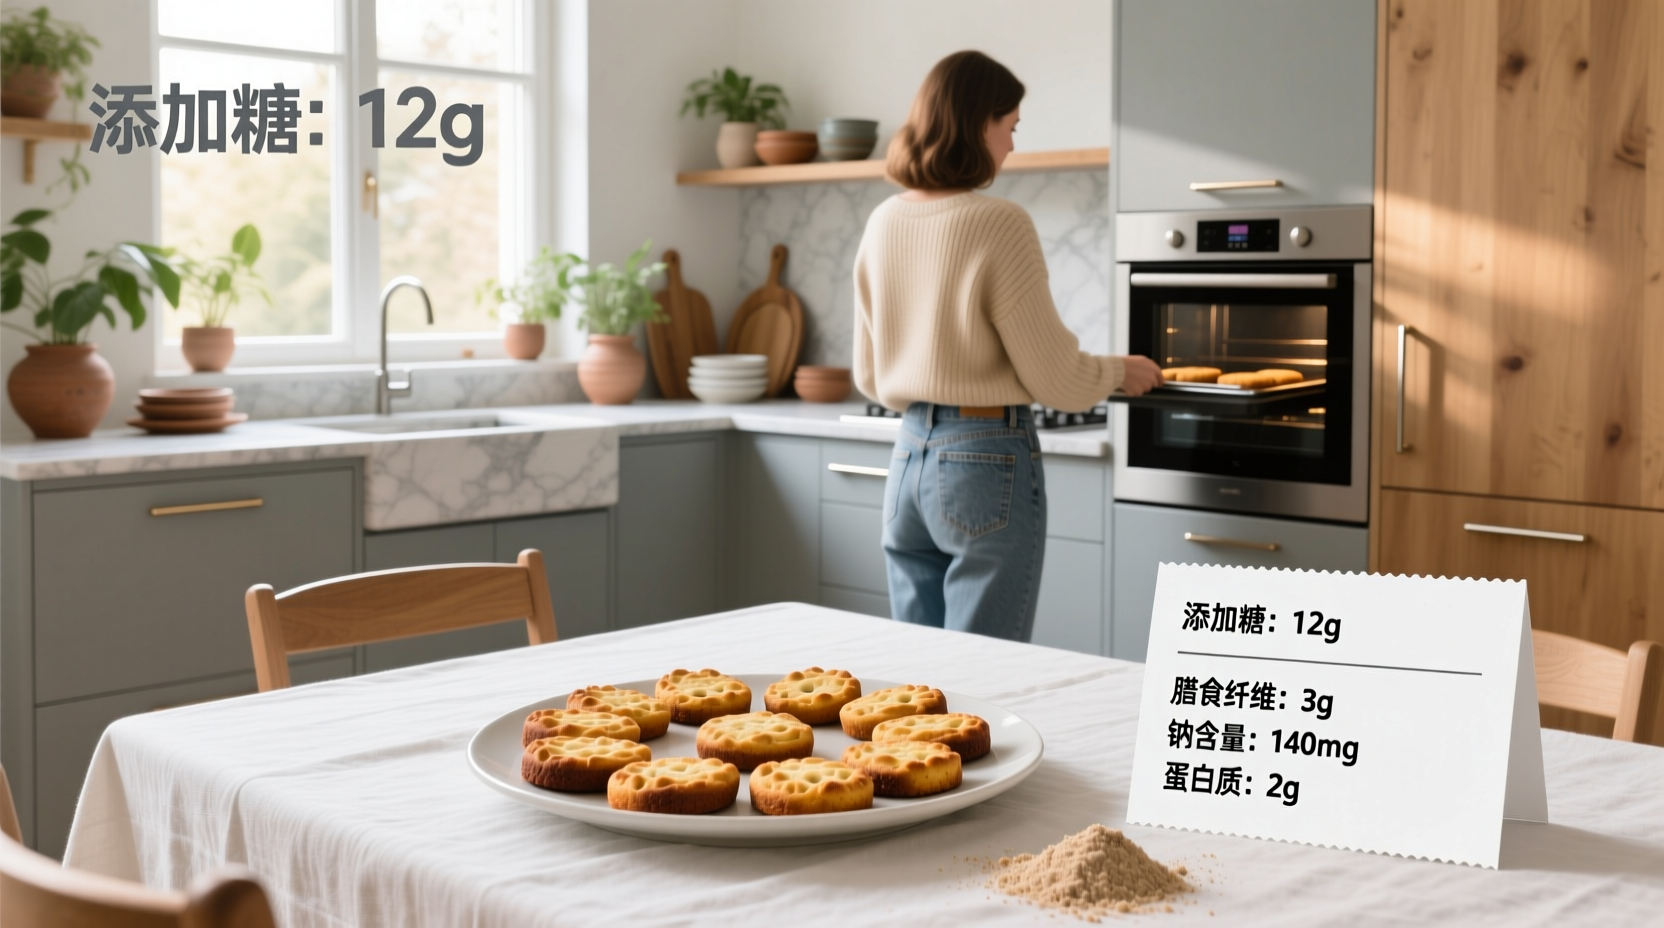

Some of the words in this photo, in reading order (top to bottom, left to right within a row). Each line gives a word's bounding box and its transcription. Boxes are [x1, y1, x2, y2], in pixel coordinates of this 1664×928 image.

[1293, 610, 1342, 645] 12g
[1300, 688, 1334, 721] 3g
[1271, 729, 1359, 767] 140mg
[1265, 772, 1300, 807] 2g
